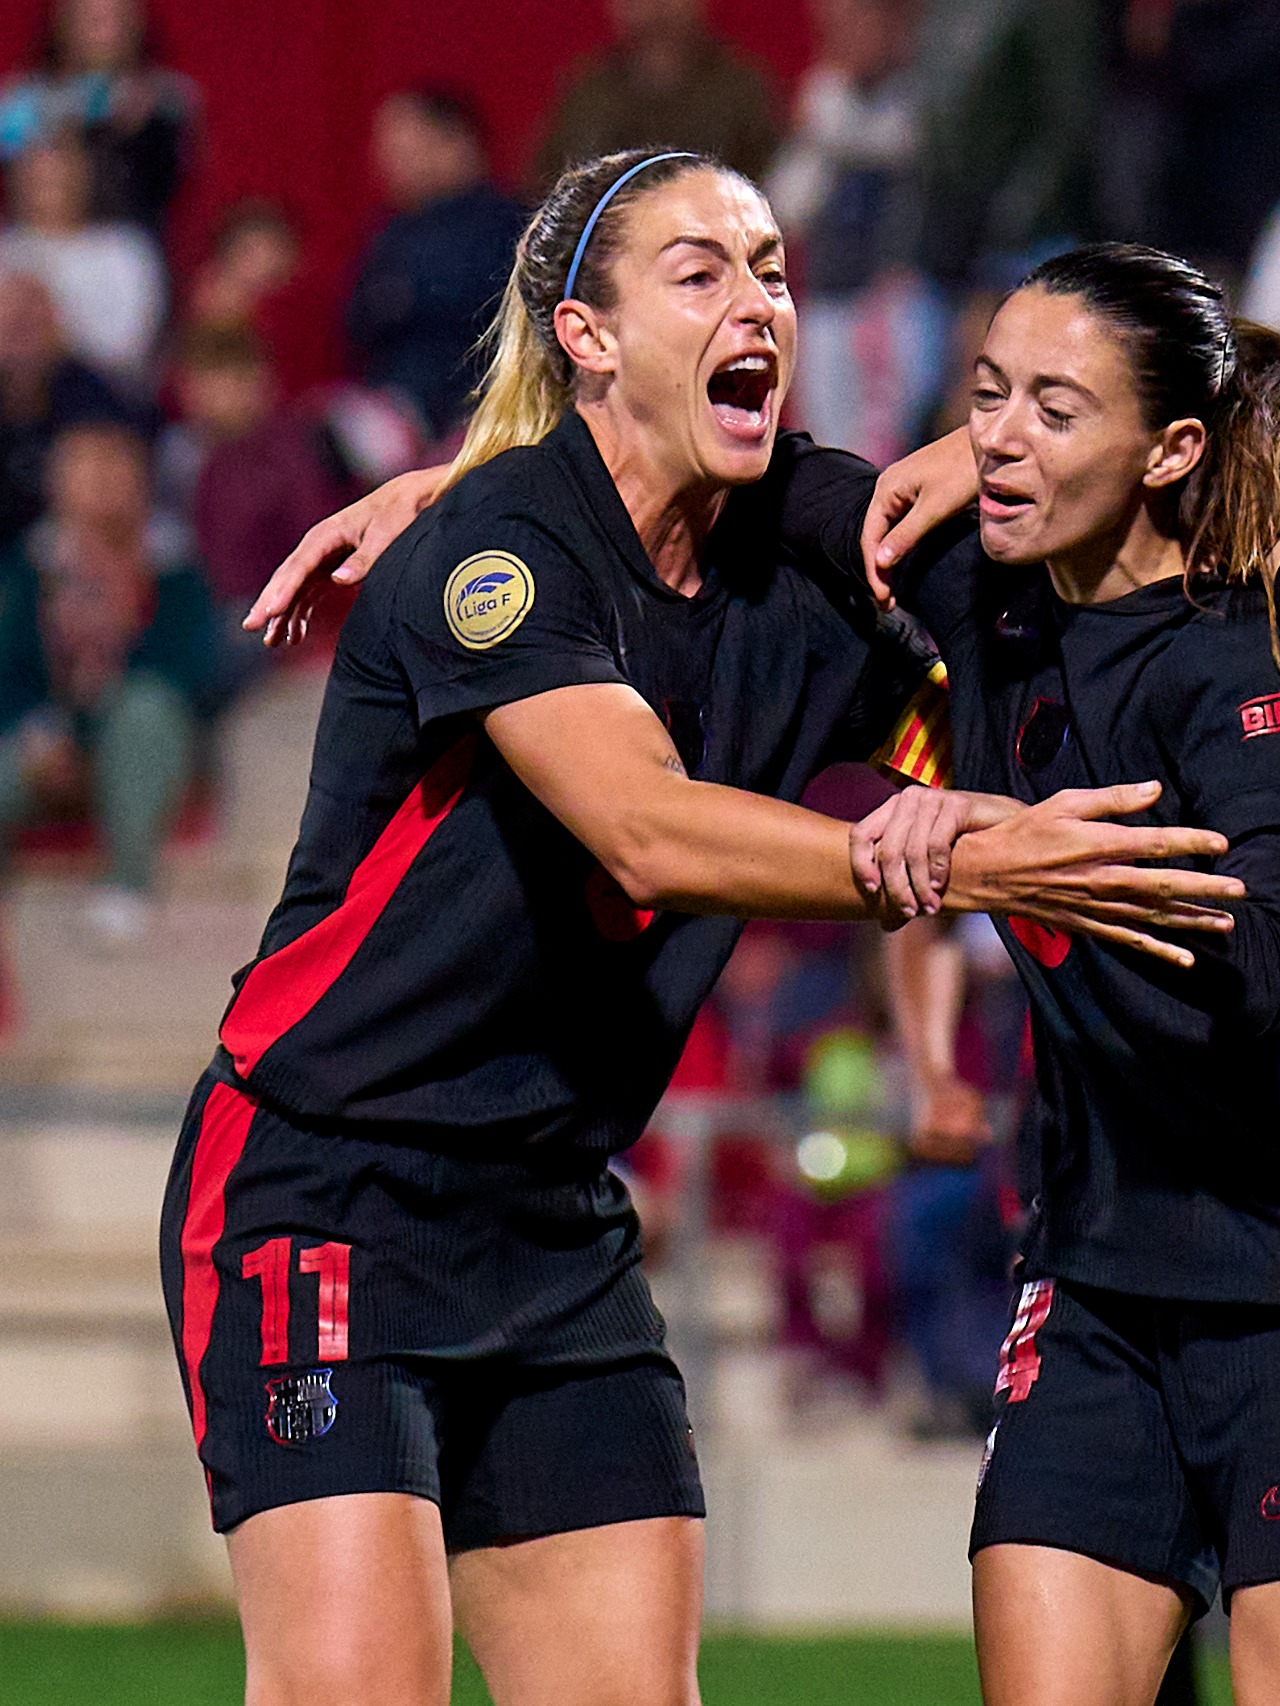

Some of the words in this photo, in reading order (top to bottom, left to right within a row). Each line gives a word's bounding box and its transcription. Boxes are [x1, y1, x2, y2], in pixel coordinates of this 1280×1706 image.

[464, 599, 498, 619] Liga
[502, 593, 511, 606] F
[241, 1236, 352, 1366] 11
